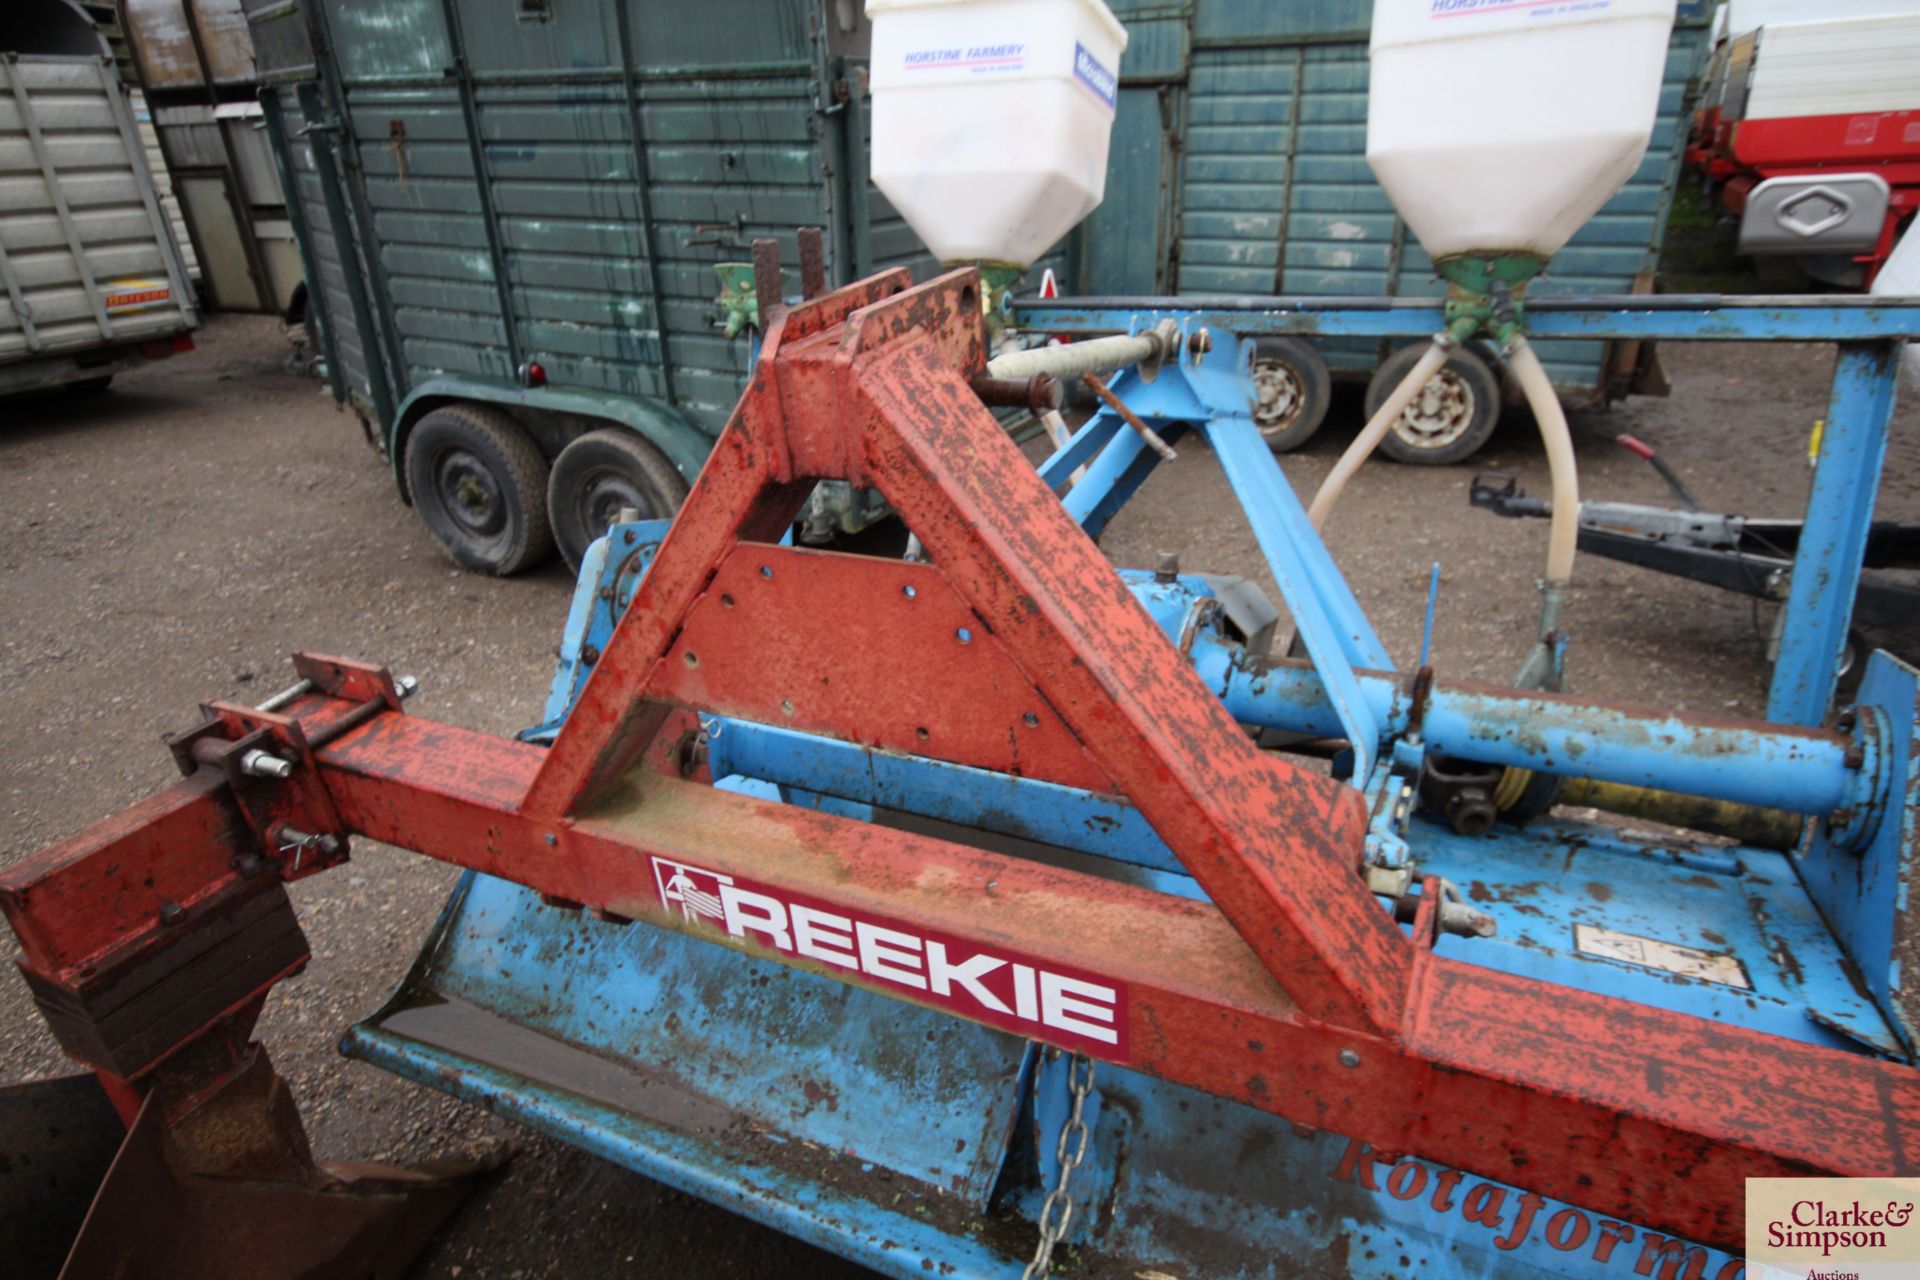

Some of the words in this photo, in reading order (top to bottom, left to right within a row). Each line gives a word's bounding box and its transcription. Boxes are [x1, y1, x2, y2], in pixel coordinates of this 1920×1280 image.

[905, 48, 961, 63] HORSTINE
[967, 44, 1024, 59] FARMERY
[719, 884, 1118, 1045] REEKIE
